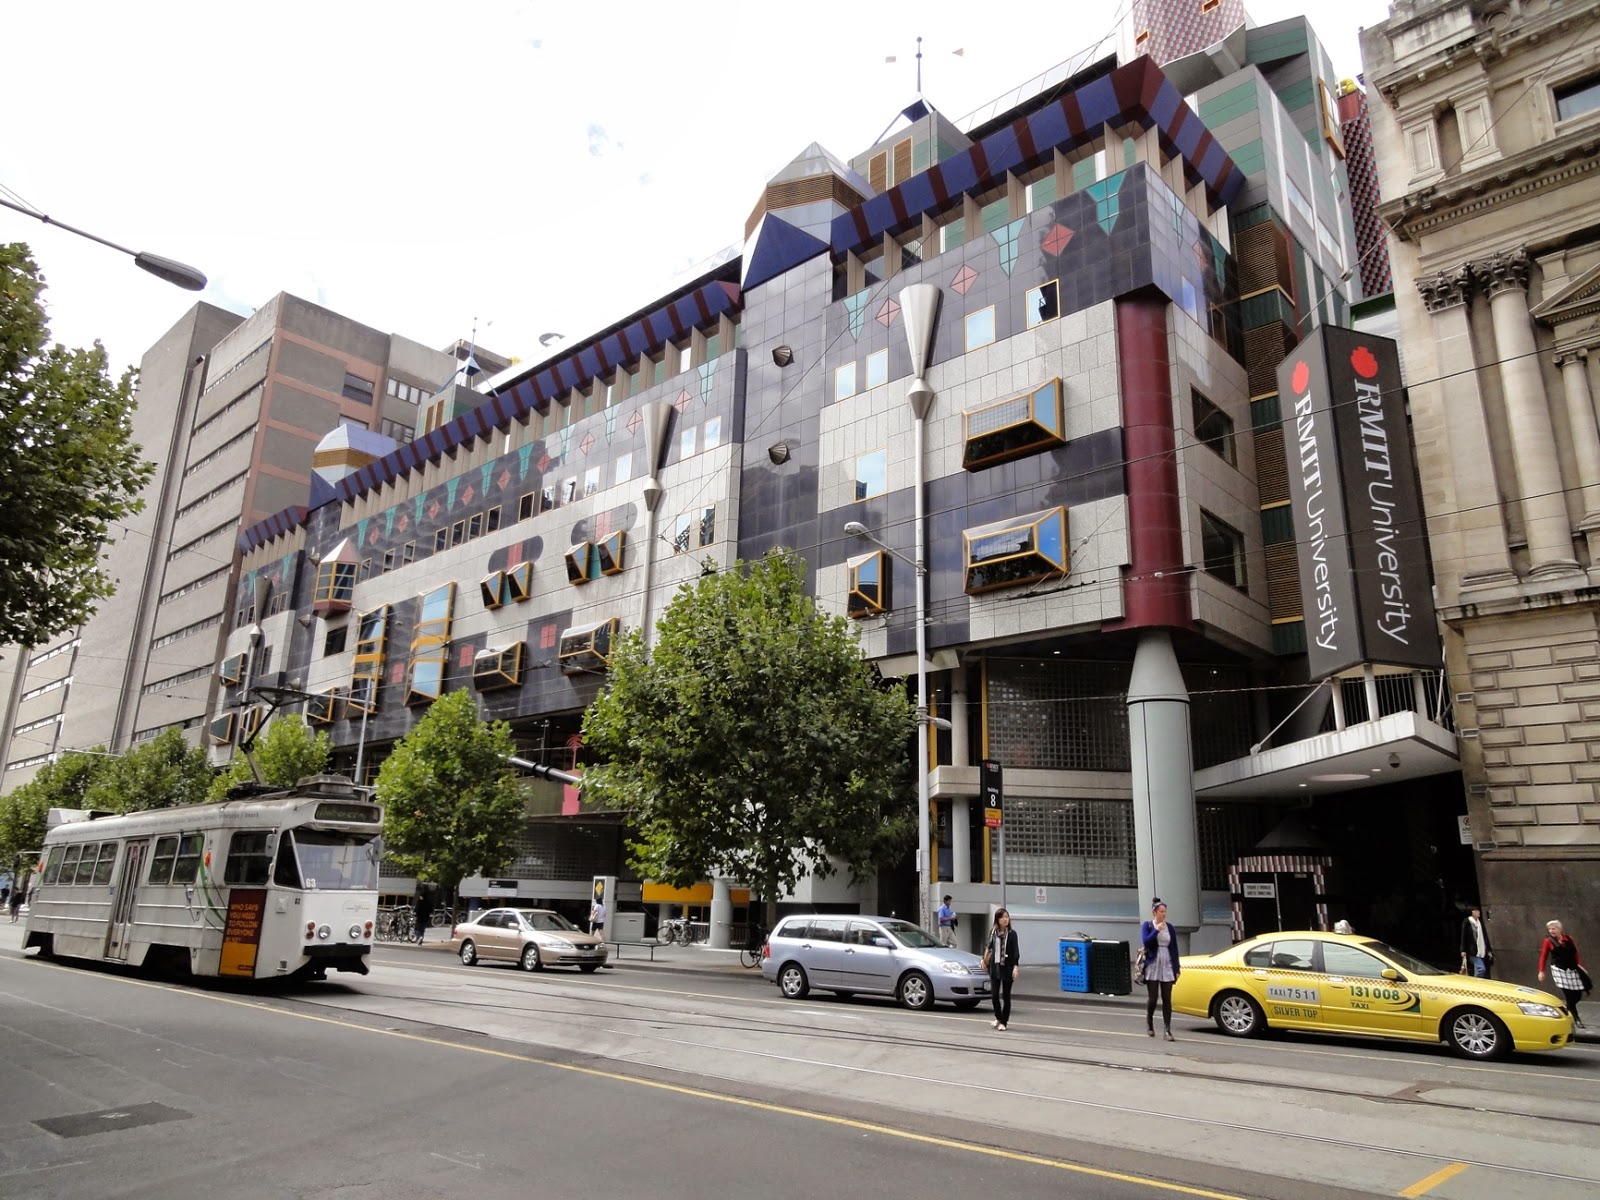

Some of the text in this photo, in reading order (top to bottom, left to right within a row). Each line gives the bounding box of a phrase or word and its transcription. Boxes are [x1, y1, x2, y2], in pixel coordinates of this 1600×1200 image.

[1354, 378, 1411, 646] RMIT University
[1294, 389, 1339, 651] RMIT University
[990, 794, 996, 807] 8
[305, 878, 316, 888] 63
[230, 903, 259, 911] WHO SAYS
[229, 911, 241, 919] YOU
[228, 919, 259, 928] TO FOLLOW
[226, 928, 255, 936] EVERYONE
[1269, 988, 1316, 1001] TAXI 7511
[1349, 985, 1400, 1001] 131 008
[1350, 1002, 1370, 1010] TAXI
[1273, 1006, 1318, 1019] SILVER TOP
